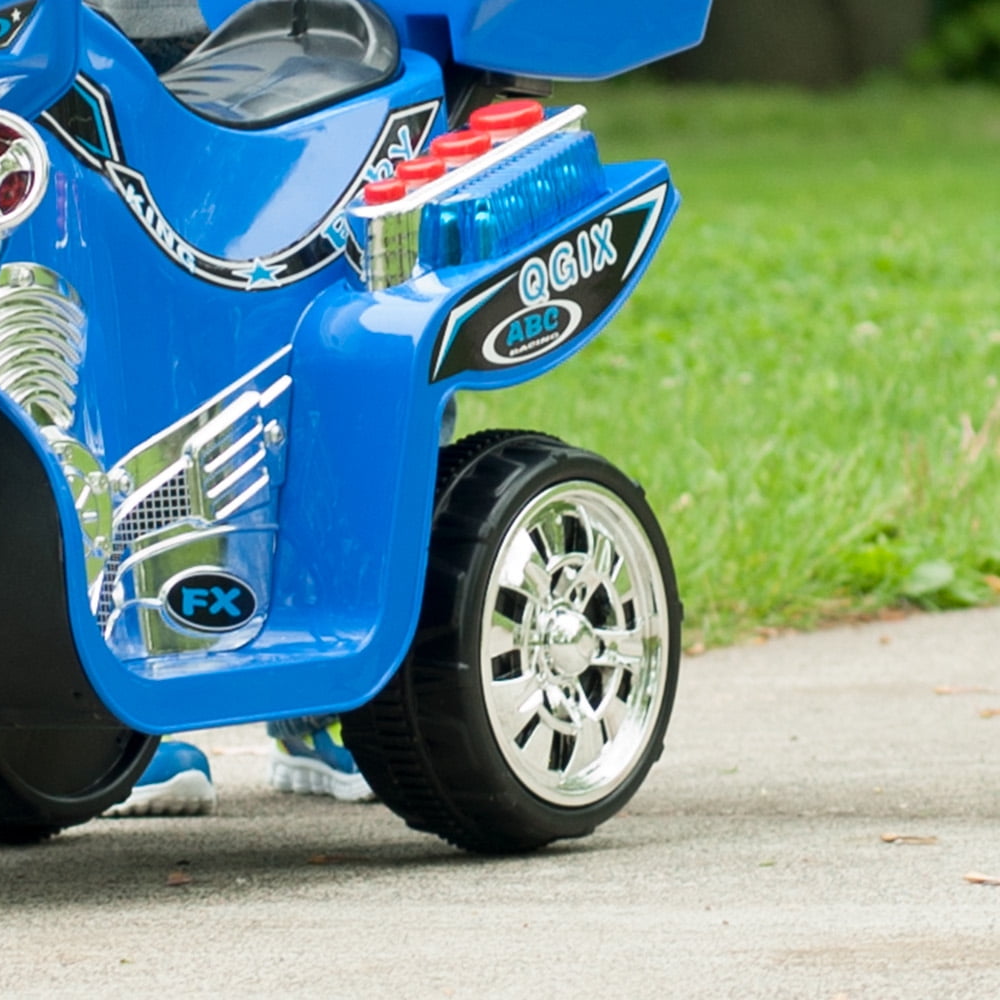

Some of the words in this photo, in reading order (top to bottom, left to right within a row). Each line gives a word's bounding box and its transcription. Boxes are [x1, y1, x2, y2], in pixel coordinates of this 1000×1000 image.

[126, 183, 196, 274] KING
[518, 217, 618, 307] QGIX
[506, 306, 560, 346] ABC
[182, 585, 241, 617] FX
